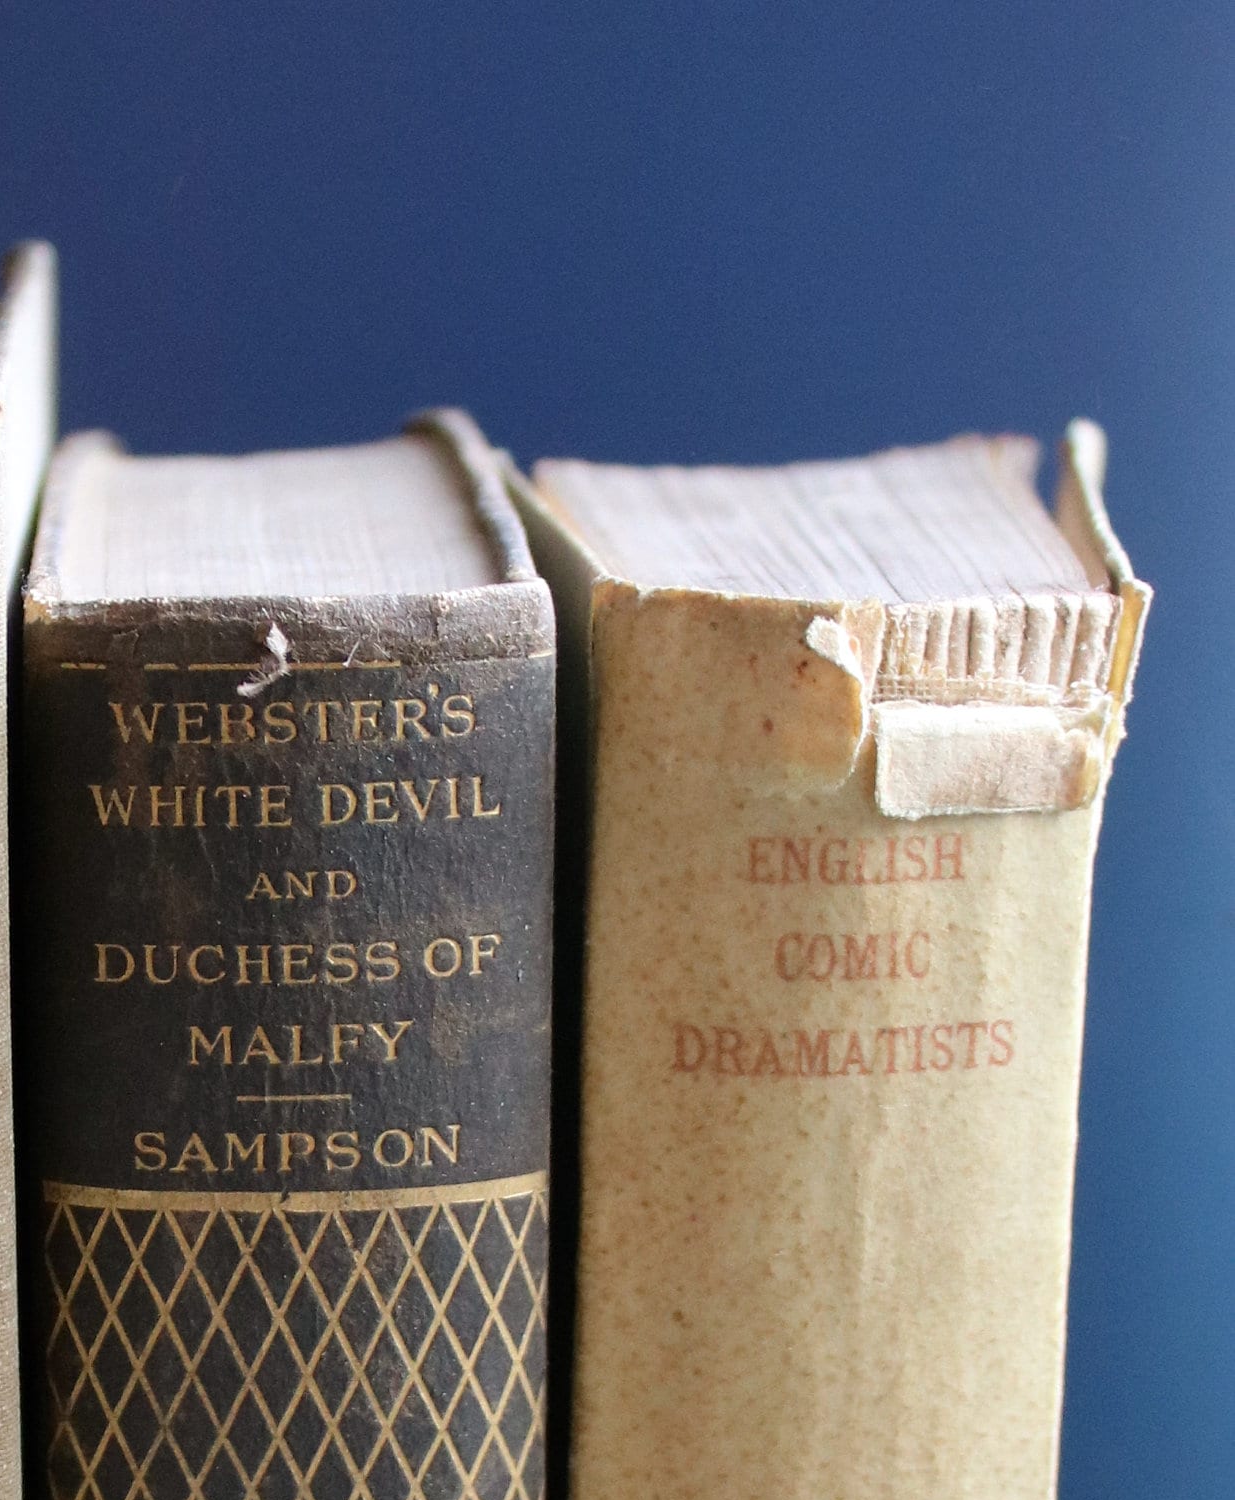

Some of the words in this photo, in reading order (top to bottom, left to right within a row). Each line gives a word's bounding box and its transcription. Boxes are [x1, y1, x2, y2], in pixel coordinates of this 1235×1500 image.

[109, 682, 476, 745] WEBSTER'S
[88, 785, 293, 828] WHITE
[319, 776, 502, 826] DEVIL
[245, 869, 359, 901] AND
[744, 832, 966, 887] ENGLISH
[93, 939, 403, 987] DUCHESS
[422, 933, 502, 979] OF
[773, 930, 933, 984] COMIC
[189, 1019, 414, 1066] MALFY
[670, 1017, 1016, 1078] DRAMATISTS
[133, 1123, 463, 1174] SAMPSON
